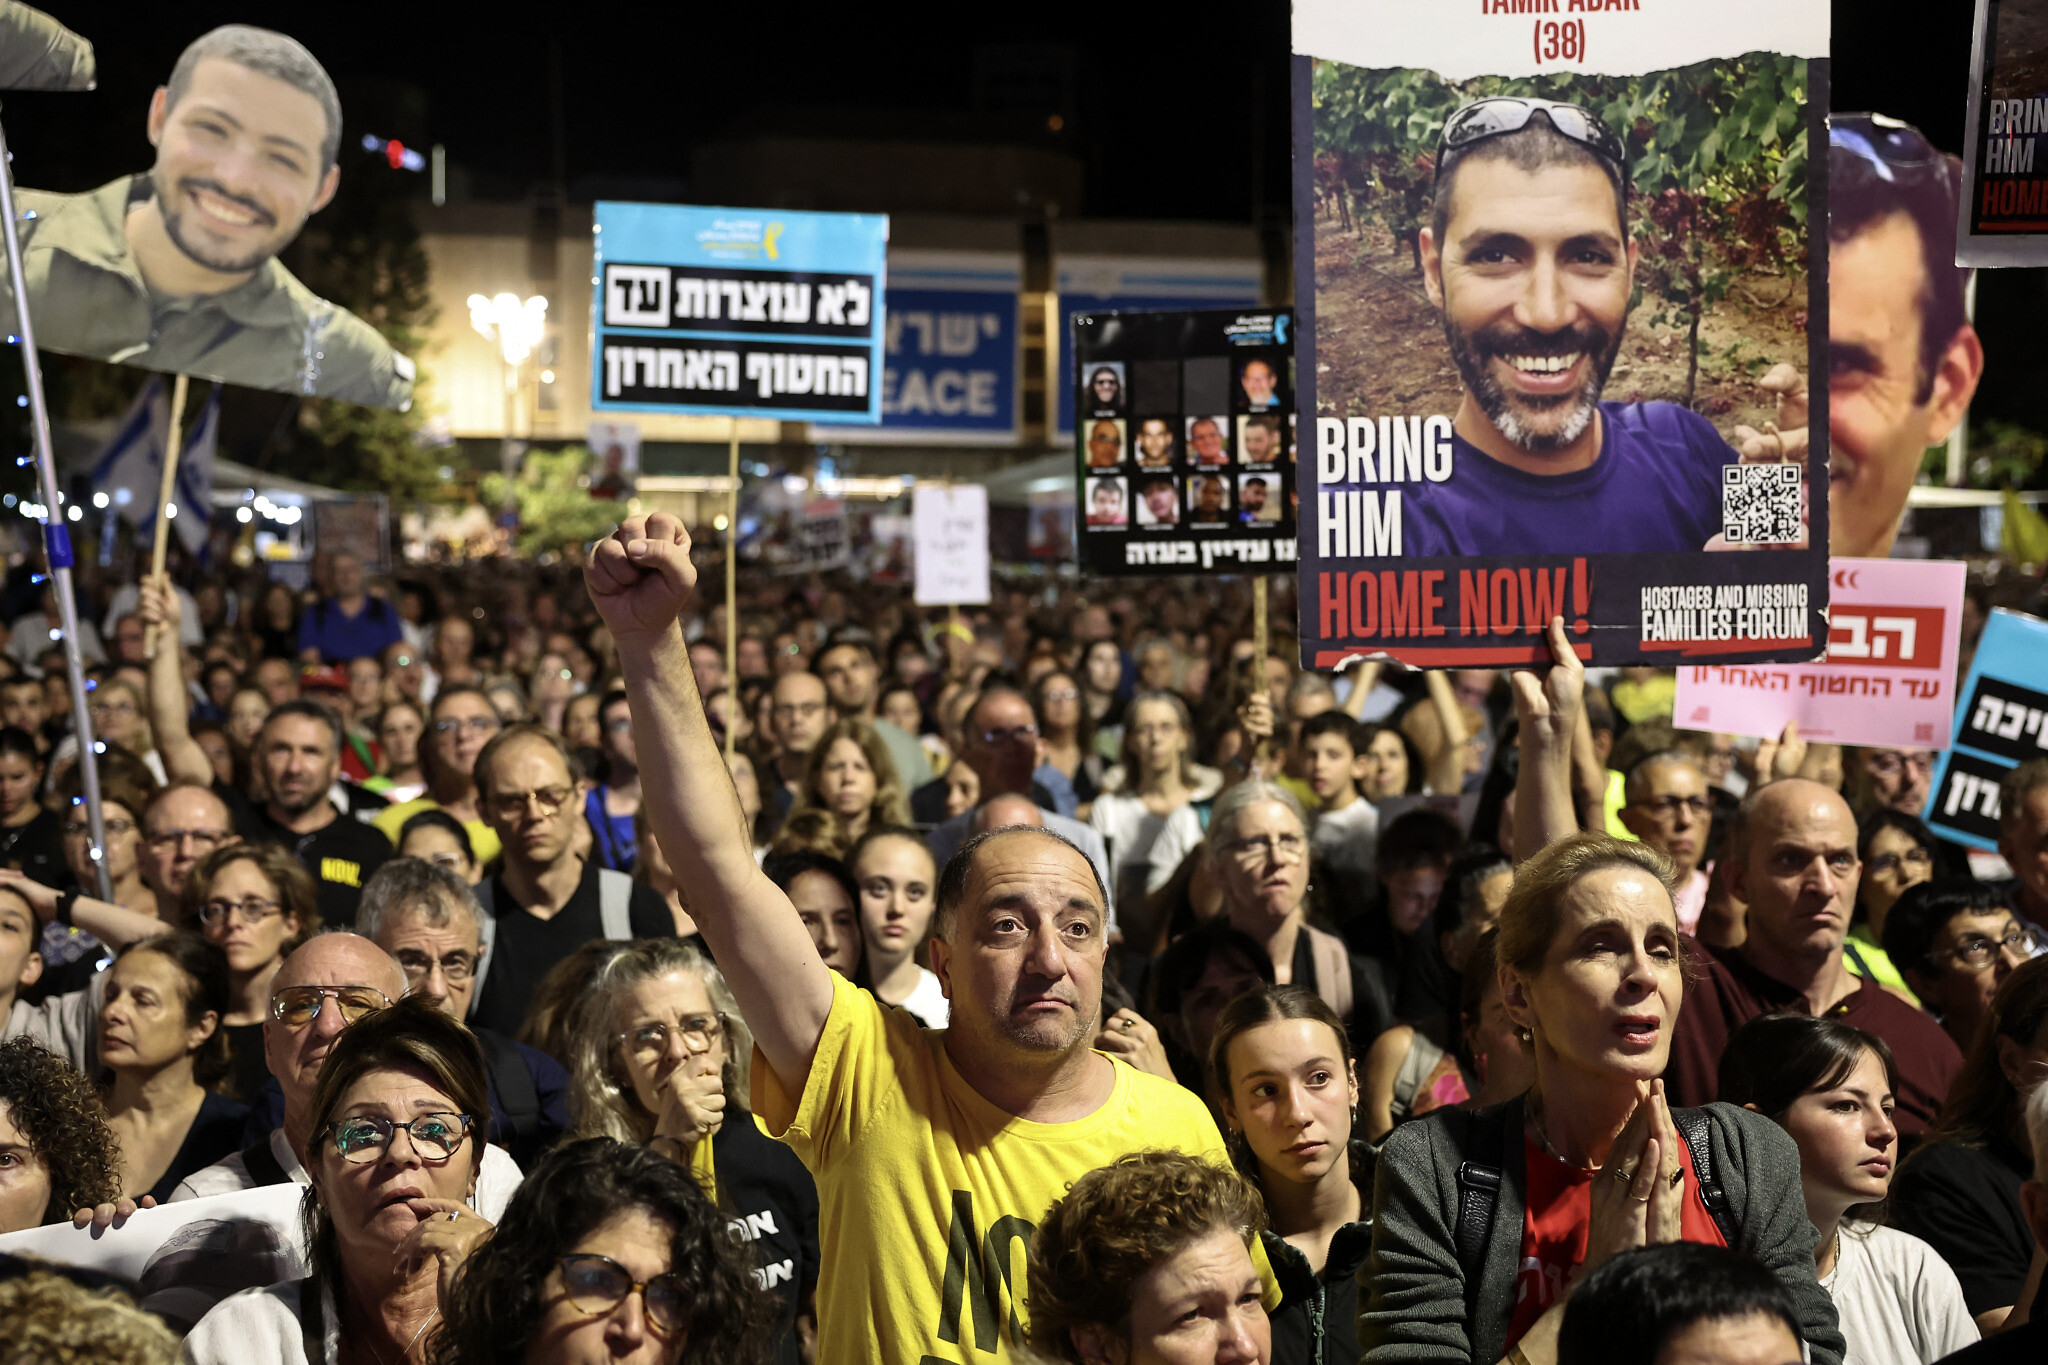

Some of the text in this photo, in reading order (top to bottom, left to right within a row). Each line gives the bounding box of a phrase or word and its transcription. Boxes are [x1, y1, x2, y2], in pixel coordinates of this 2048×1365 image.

[1534, 18, 1586, 65] (38)
[1985, 138, 2035, 174] HIM
[615, 277, 871, 326] לא עוצרות עד
[604, 345, 869, 398] החטוף האחרון
[1317, 415, 1453, 484] BRING
[1318, 490, 1402, 557] HIM
[1125, 541, 1197, 565] בעזה
[1200, 538, 1270, 569] עדיין
[1319, 557, 1592, 639] HOME NOW!
[1641, 583, 1808, 611] HOSTAGES AND MISSING
[1641, 606, 1808, 642] FAMILIES FORUM
[1799, 674, 1891, 698] החטוף
[1902, 678, 1940, 699] עד
[1943, 770, 2001, 821] רון
